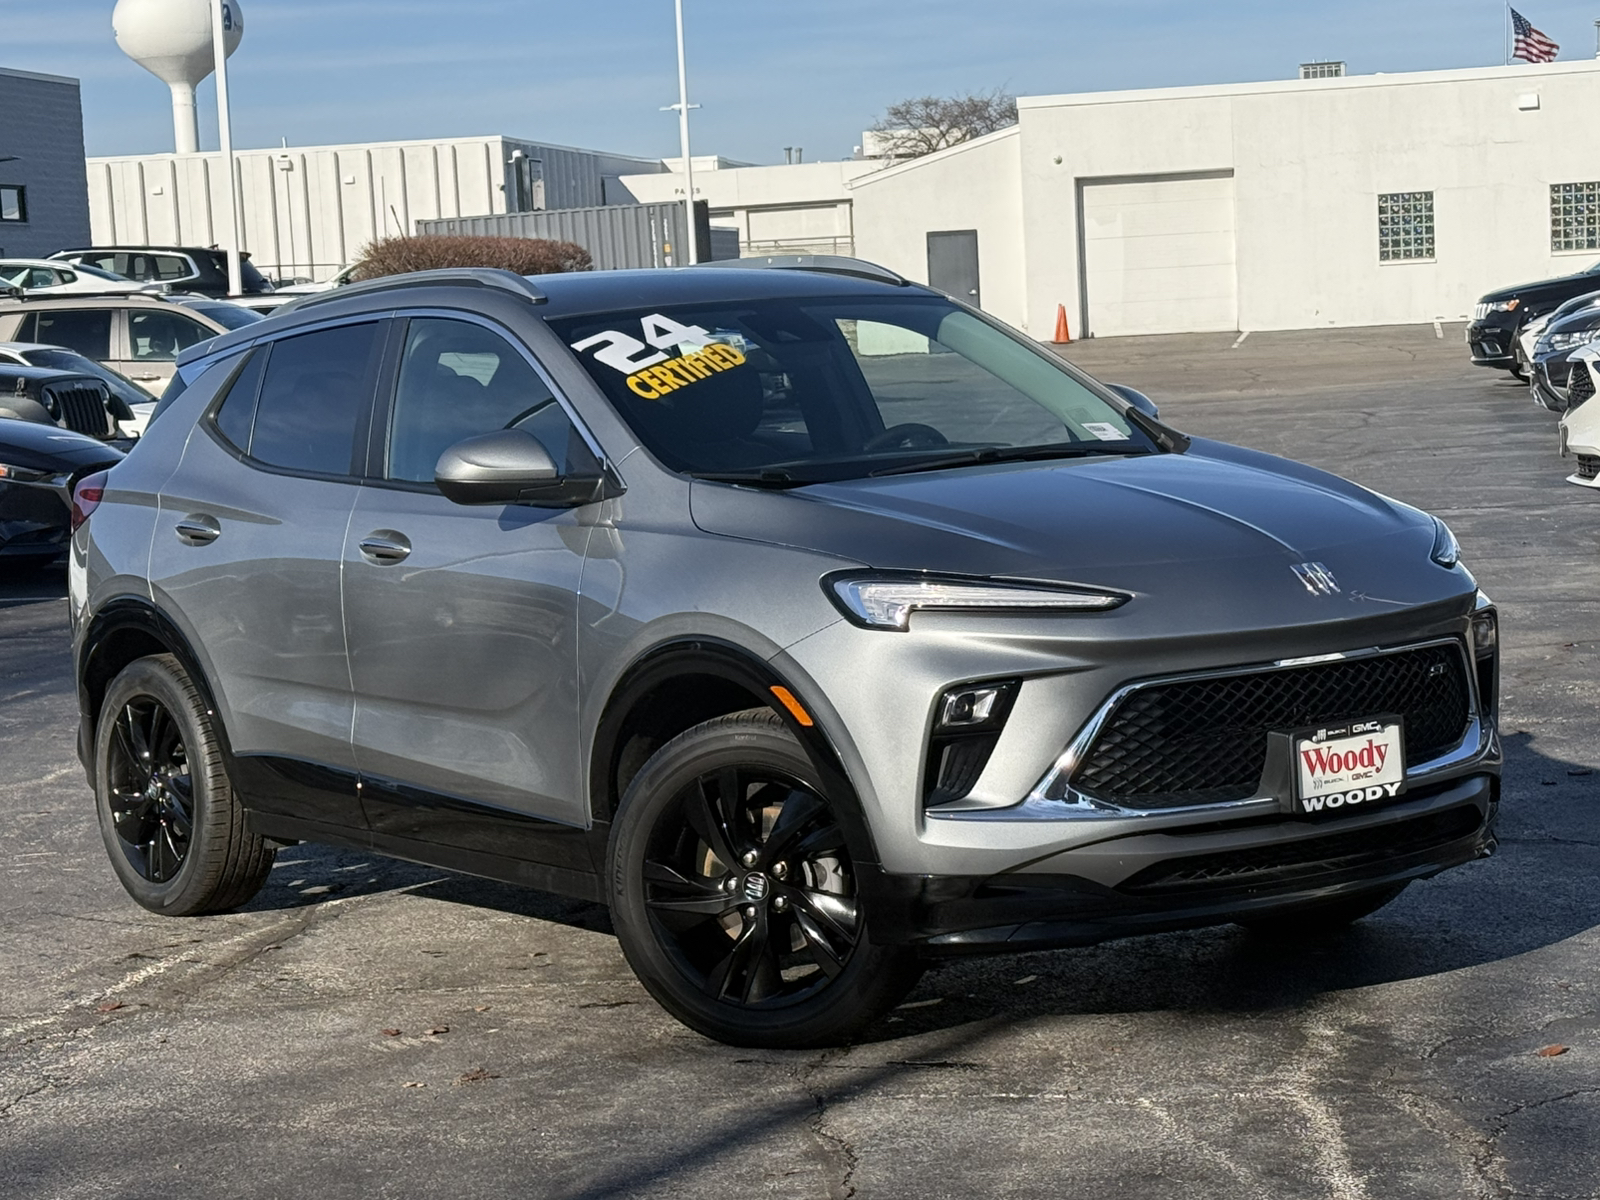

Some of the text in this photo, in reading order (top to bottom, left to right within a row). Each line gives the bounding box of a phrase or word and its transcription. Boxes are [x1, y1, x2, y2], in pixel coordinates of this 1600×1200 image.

[675, 187, 700, 195] PAS
[570, 313, 710, 375] 24
[626, 343, 746, 399] CERTIFIED
[1352, 721, 1378, 733] GMC
[1301, 739, 1388, 778] Woody
[1352, 771, 1373, 781] GMC
[1302, 782, 1401, 813] WOODY
